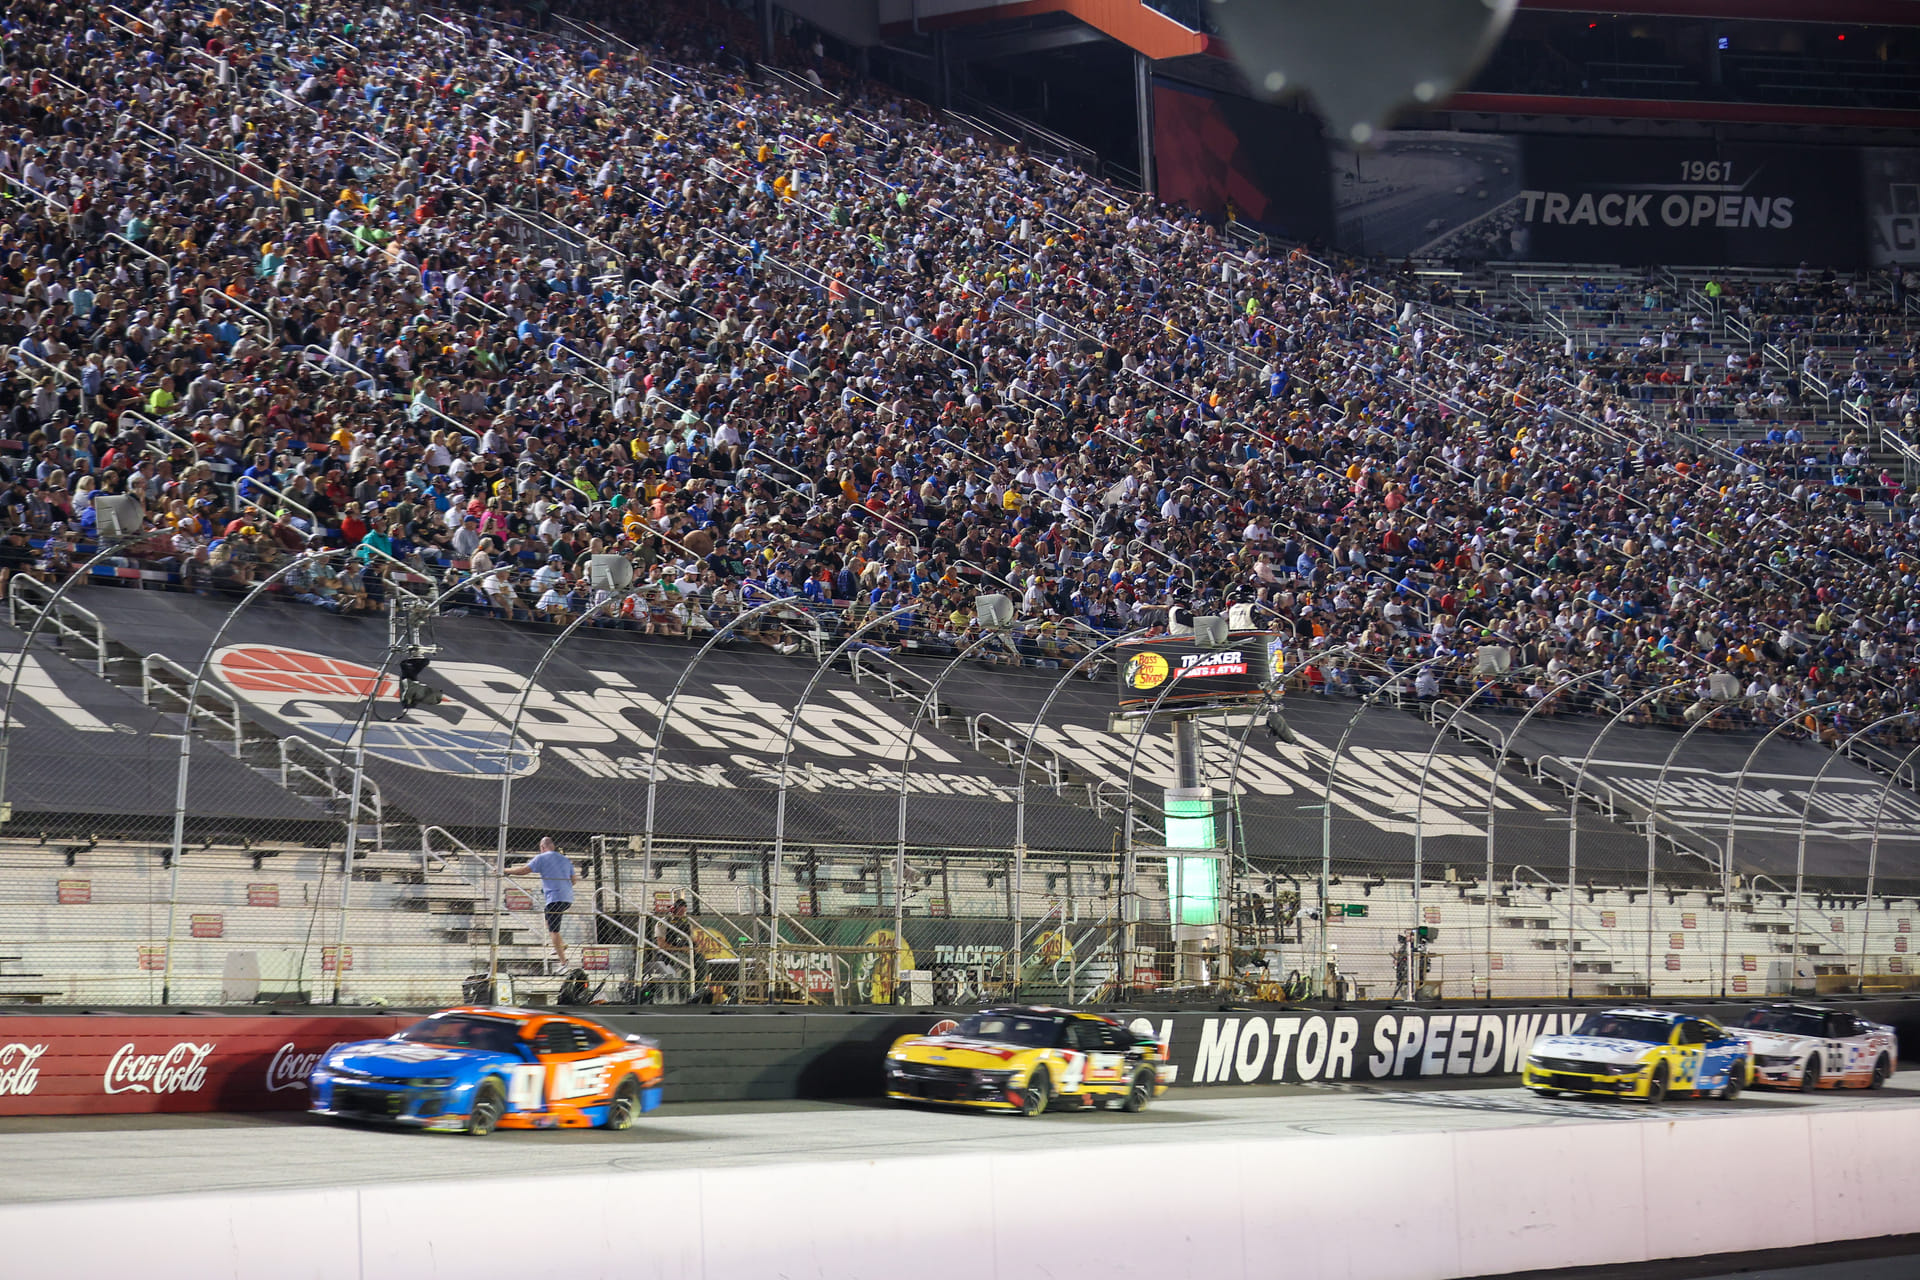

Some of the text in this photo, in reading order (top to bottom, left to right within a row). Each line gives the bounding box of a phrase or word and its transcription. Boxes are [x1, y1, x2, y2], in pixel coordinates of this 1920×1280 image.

[1680, 161, 1732, 182] 1961
[1520, 190, 1794, 229] TRACK OPENS
[1139, 654, 1158, 664] Bass
[1139, 665, 1154, 675] Pro
[1181, 651, 1242, 668] TRACKER
[1139, 673, 1163, 685] Shops
[430, 660, 961, 764] Bristol
[551, 747, 1015, 803] Motor Speedway
[1348, 746, 1557, 812] CITY
[934, 945, 1003, 964] TRACKER
[1192, 1015, 1359, 1083] MOTOR
[104, 1042, 216, 1094] Coca-Cola
